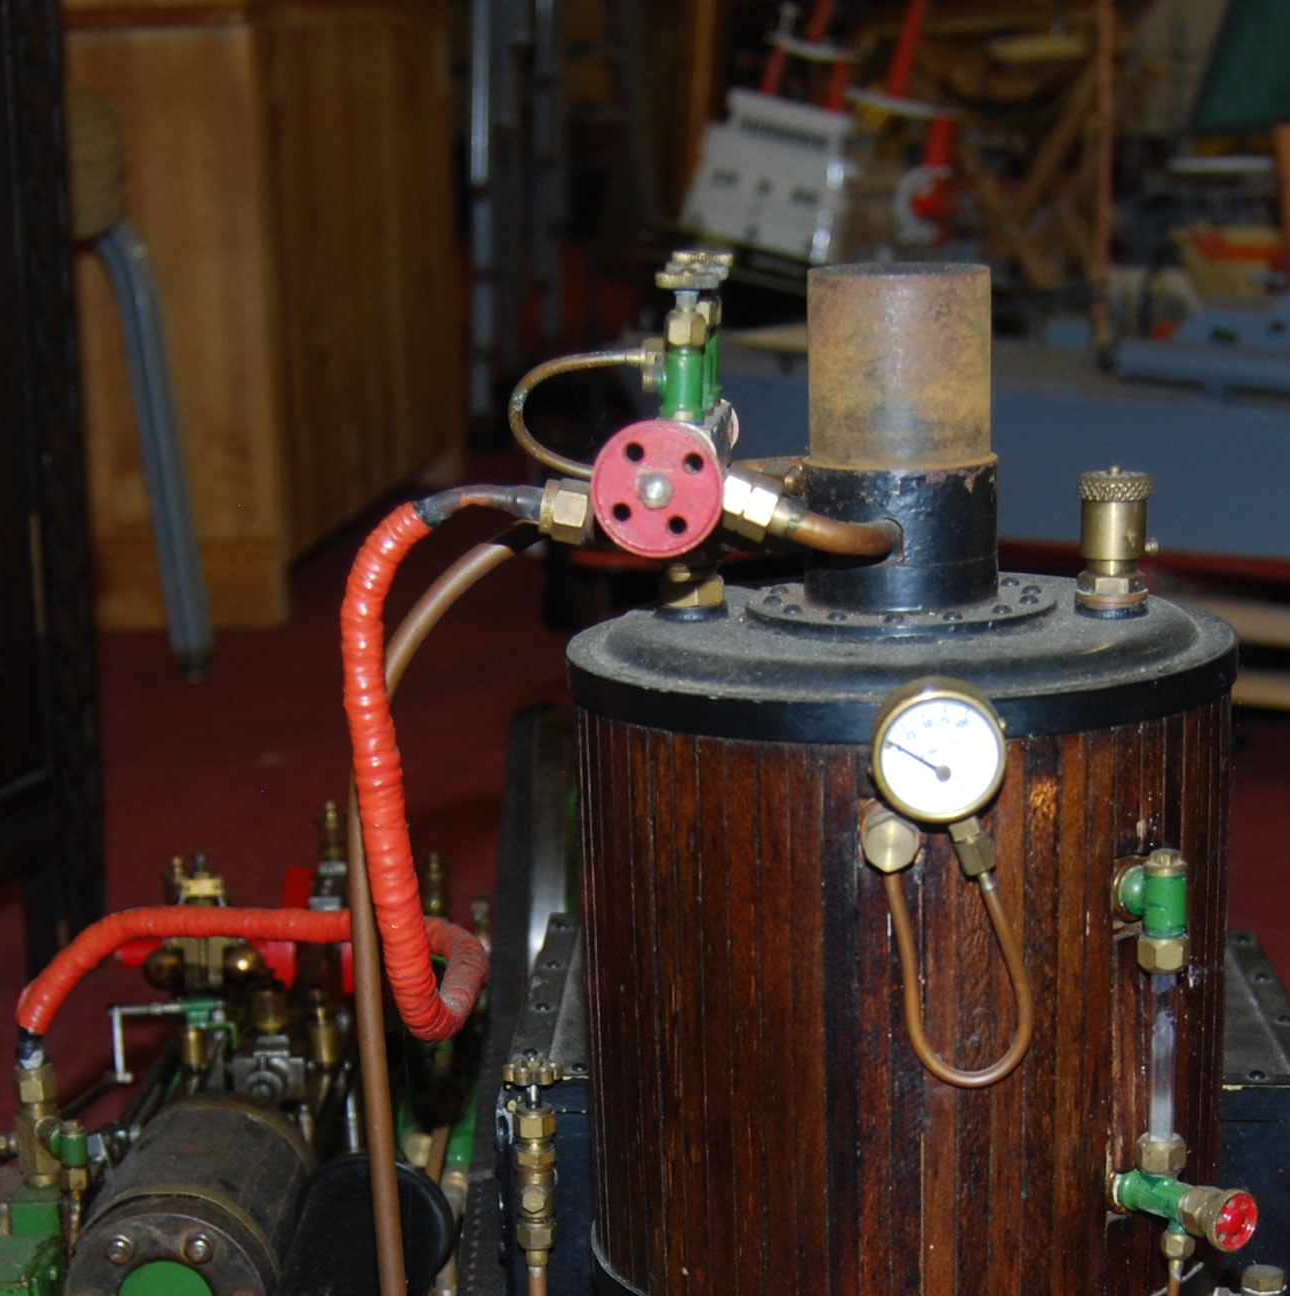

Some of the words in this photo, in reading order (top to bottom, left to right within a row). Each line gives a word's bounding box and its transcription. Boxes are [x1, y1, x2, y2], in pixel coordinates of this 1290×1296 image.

[922, 719, 932, 728] 50
[940, 717, 950, 725] 75
[955, 717, 969, 728] 100
